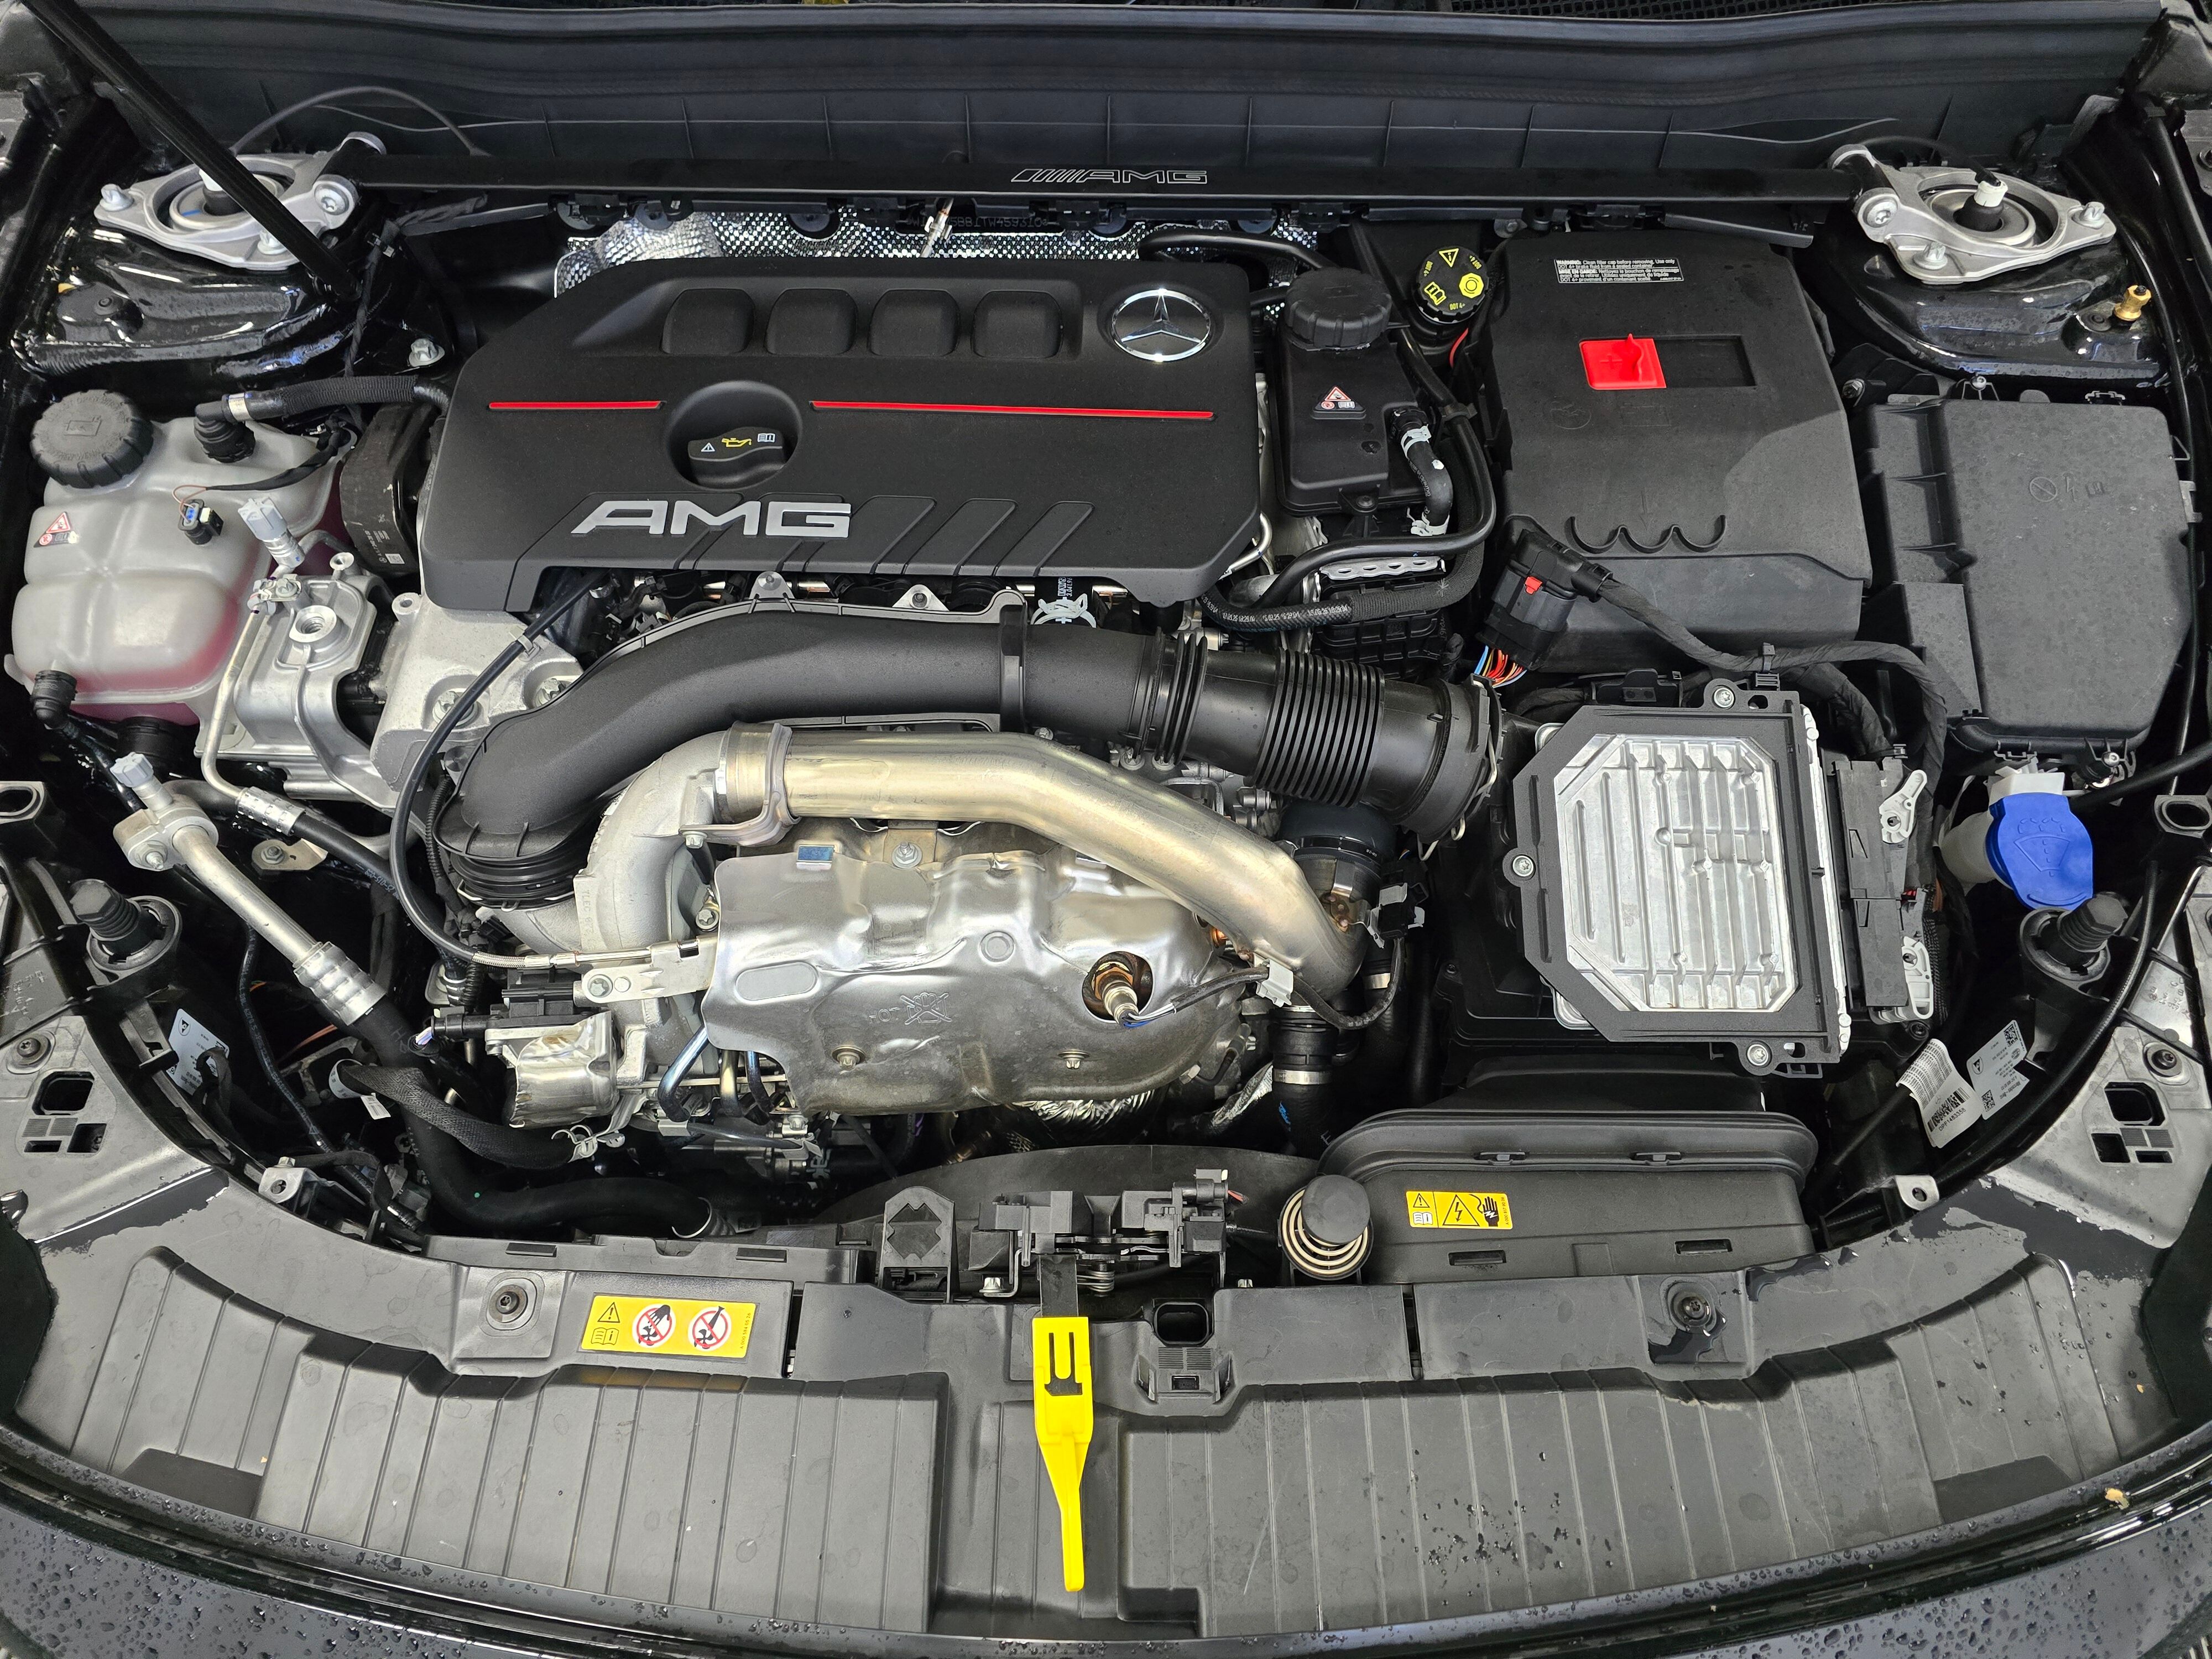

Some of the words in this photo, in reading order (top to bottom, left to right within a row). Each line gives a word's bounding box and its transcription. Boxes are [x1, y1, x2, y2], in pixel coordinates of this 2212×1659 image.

[1075, 169, 1208, 184] AMG
[912, 216, 1043, 228] W15BB1TW459310
[570, 500, 852, 538] AMG
